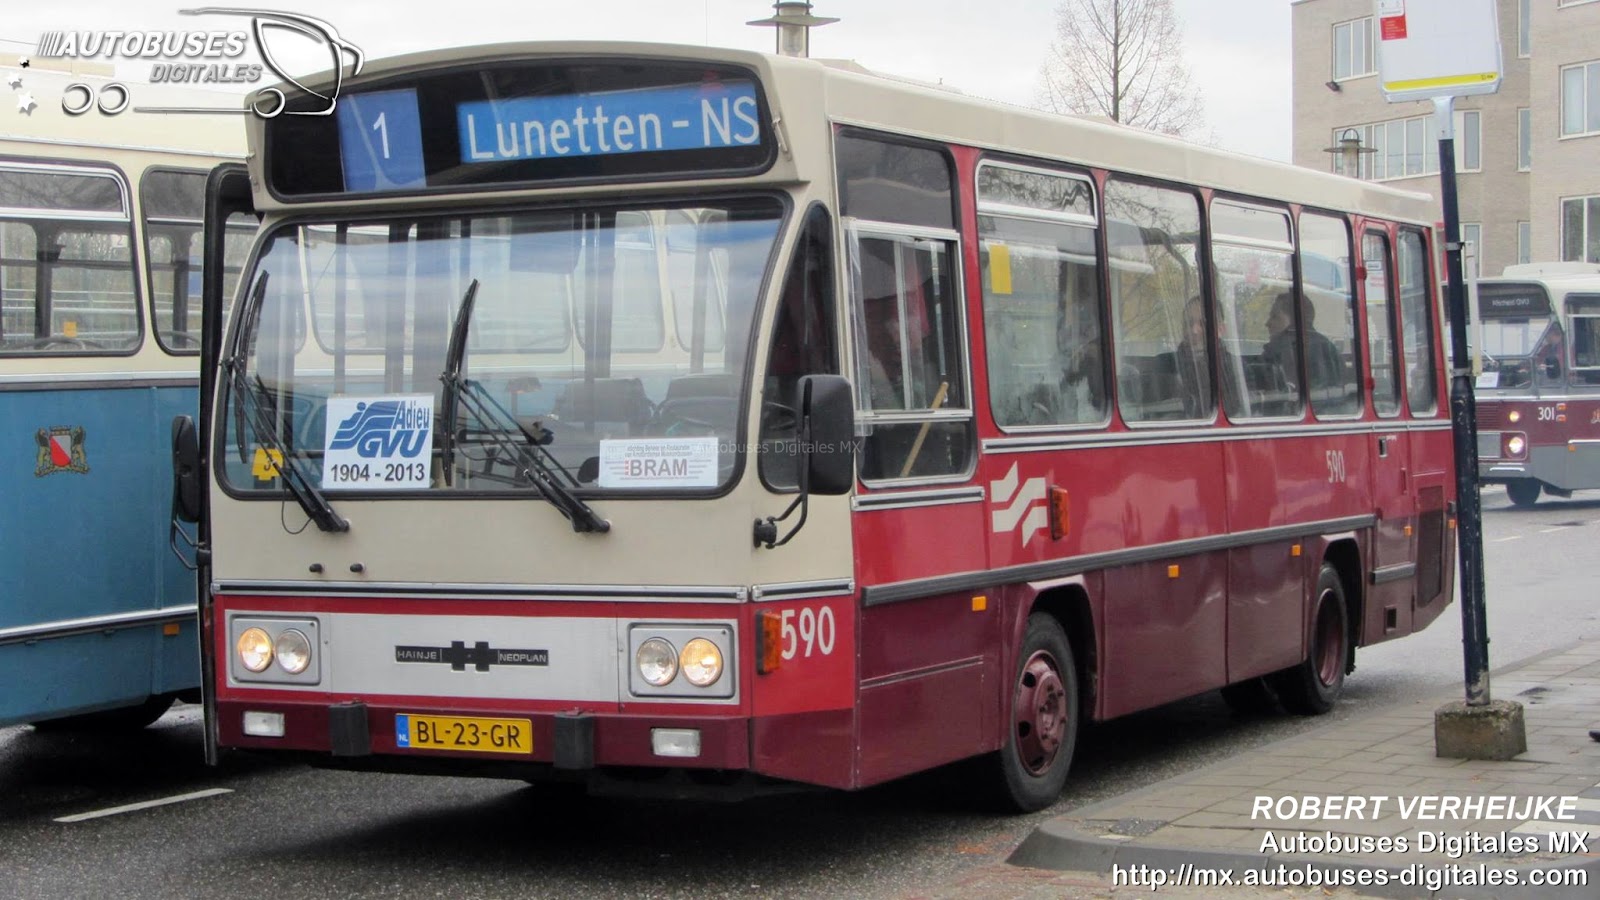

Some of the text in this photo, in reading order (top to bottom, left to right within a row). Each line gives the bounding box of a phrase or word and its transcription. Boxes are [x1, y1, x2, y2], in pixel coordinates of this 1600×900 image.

[373, 111, 390, 160] 1
[466, 105, 663, 161] Lunetten
[701, 95, 761, 146] NS
[393, 400, 430, 430] Adieu
[1538, 406, 1555, 421] 301
[357, 430, 429, 459] GVU
[330, 463, 370, 482] 1904
[384, 463, 425, 482] 2013
[629, 458, 688, 477] BRAM
[1325, 449, 1346, 483] 590
[780, 605, 836, 661] 590
[397, 650, 547, 663] HAINJE NEOPLAN
[398, 733, 408, 742] NL
[416, 720, 521, 748] BL-23-GR
